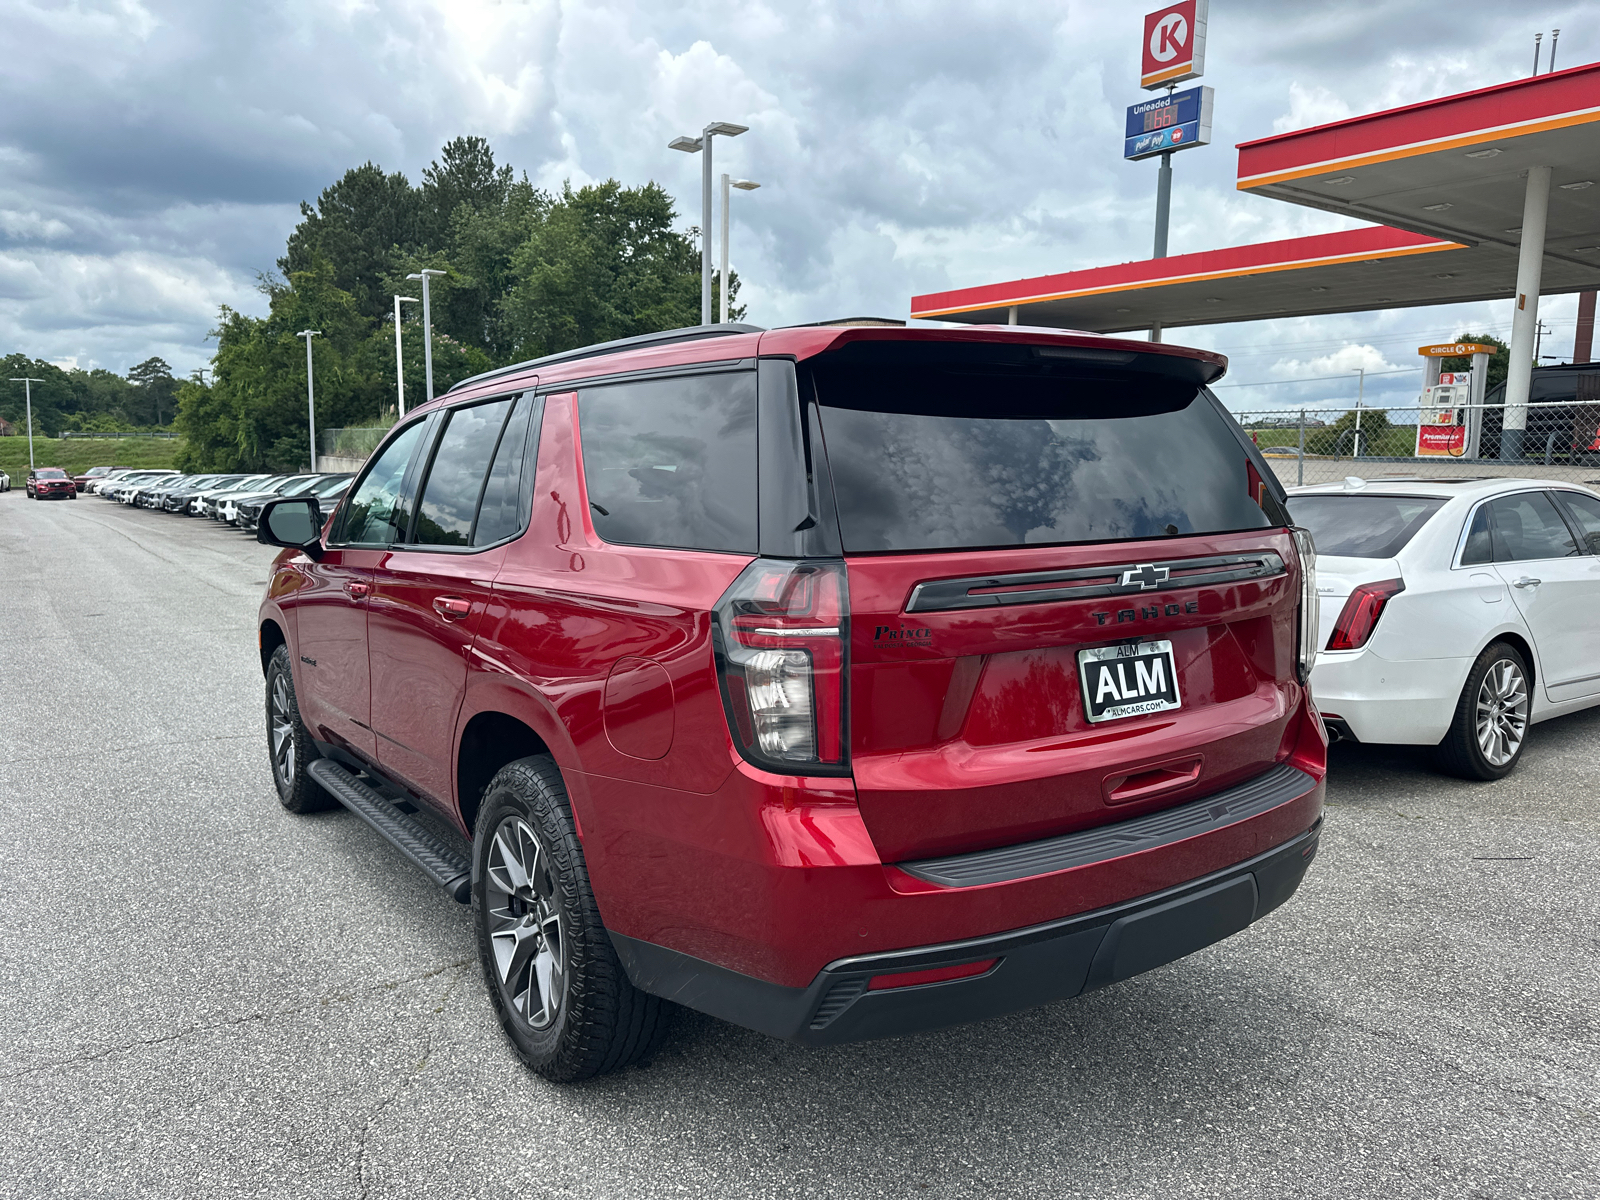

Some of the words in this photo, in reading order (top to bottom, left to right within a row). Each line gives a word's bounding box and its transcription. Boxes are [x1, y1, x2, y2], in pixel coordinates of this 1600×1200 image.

[1159, 19, 1183, 54] K
[1133, 97, 1170, 115] Unleaded
[1135, 136, 1152, 152] Polar
[1151, 134, 1164, 147] Pop
[1430, 346, 1455, 354] CIRCLE
[1092, 601, 1199, 626] TAHOE
[1116, 643, 1140, 658] ALM
[1095, 657, 1167, 704] ALM
[1111, 702, 1162, 718] ALMCARS.COM
